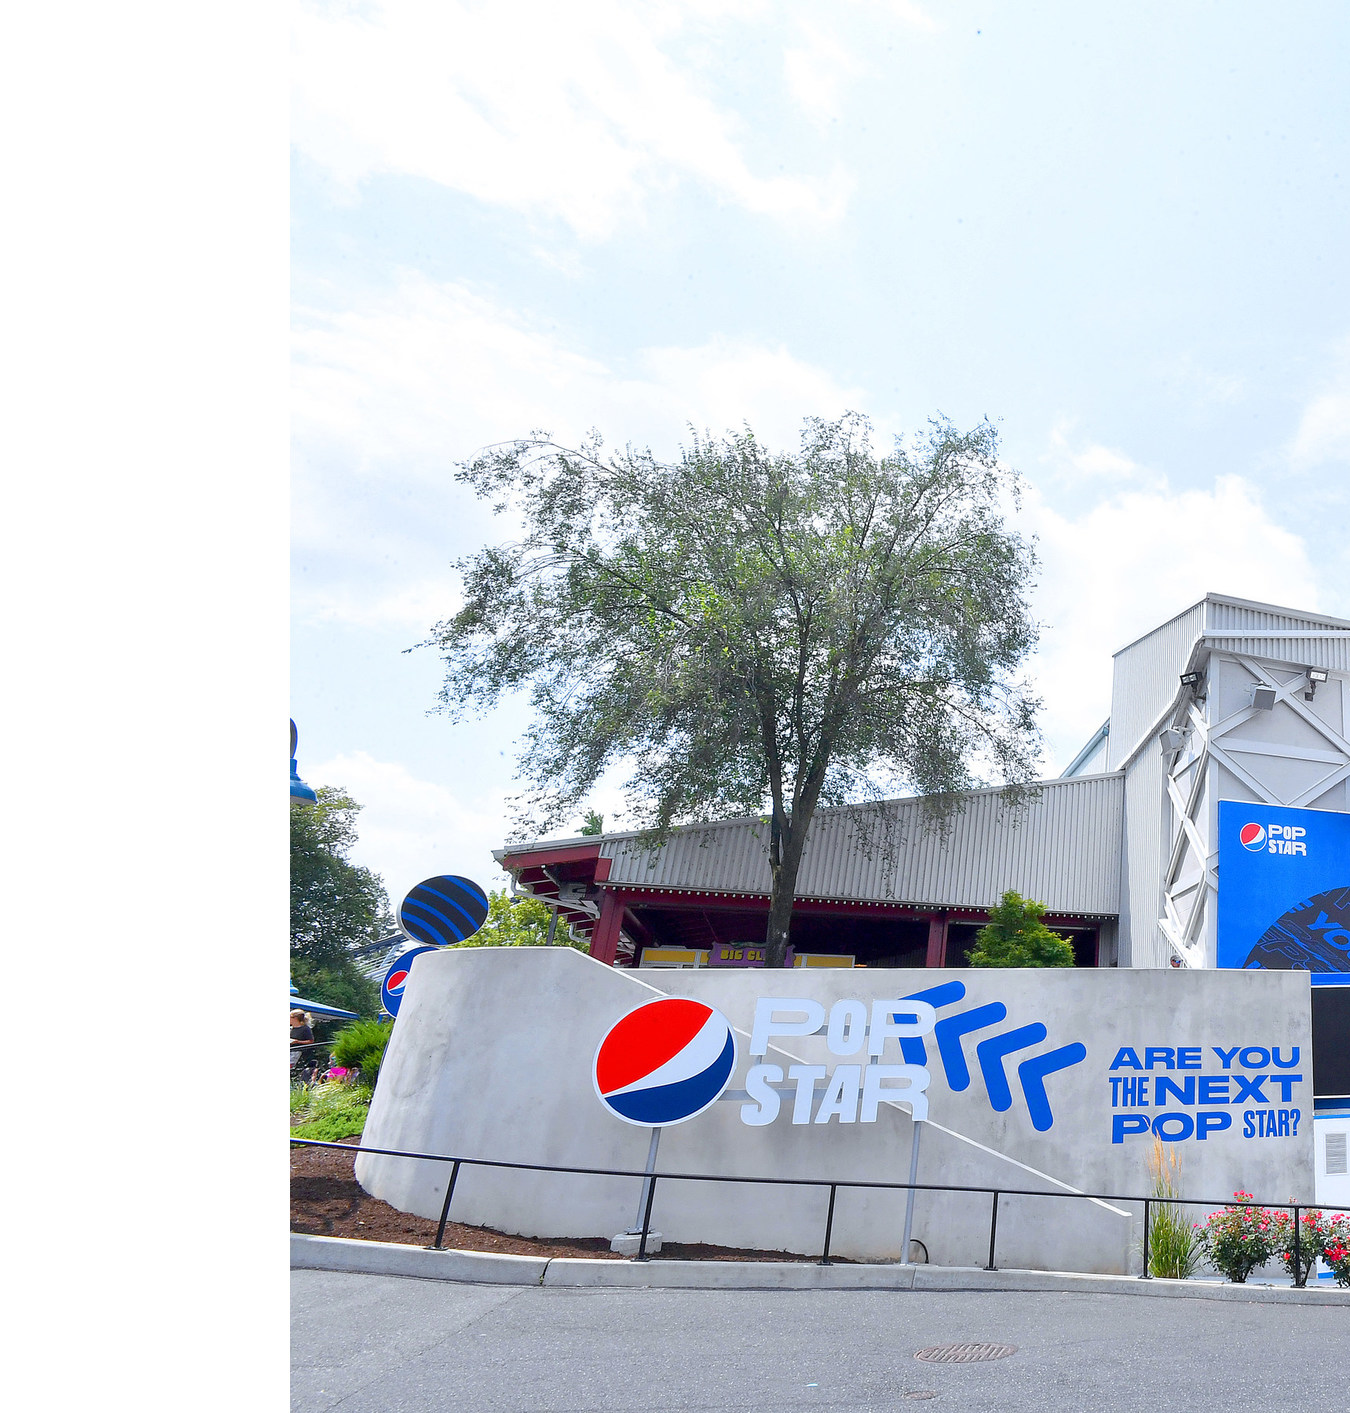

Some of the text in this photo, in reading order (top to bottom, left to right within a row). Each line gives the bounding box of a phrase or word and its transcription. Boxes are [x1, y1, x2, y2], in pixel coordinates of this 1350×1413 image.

[1268, 824, 1307, 840] POP
[1268, 839, 1307, 856] STAR
[721, 950, 743, 960] BIG
[749, 997, 937, 1056] POP
[1109, 1046, 1300, 1070] ARE YOU
[740, 1063, 931, 1126] STAR
[1109, 1074, 1302, 1107] THE NEXT
[1111, 1108, 1301, 1144] POP STAR?
